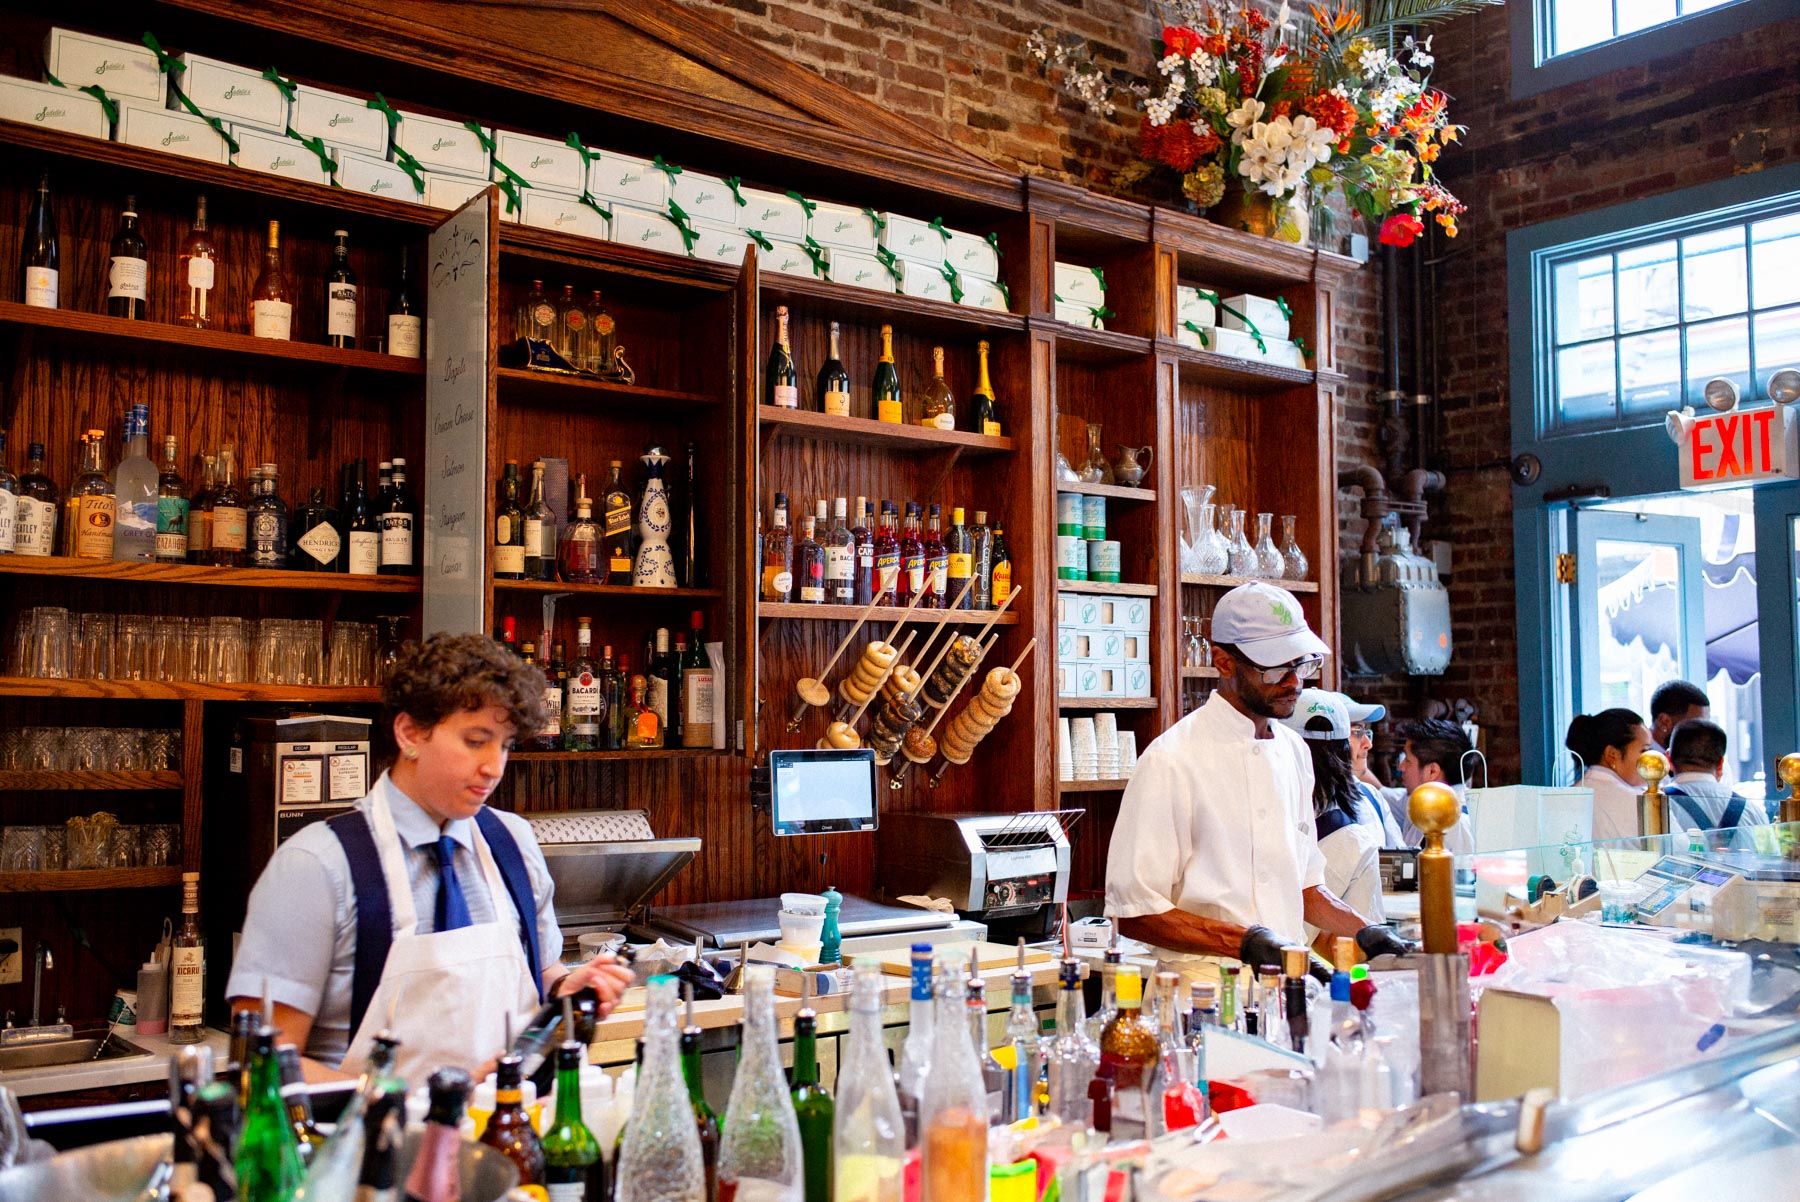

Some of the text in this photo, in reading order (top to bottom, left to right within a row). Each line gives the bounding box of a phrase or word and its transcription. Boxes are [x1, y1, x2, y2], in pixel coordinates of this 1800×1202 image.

[444, 357, 466, 385] Bagels
[1691, 410, 1775, 481] EXIT
[441, 455, 465, 479] Salmon
[86, 499, 114, 511] Tito's
[15, 523, 38, 534] EATLEY
[441, 554, 462, 575] Caviar
[176, 967, 200, 976] XICARU
